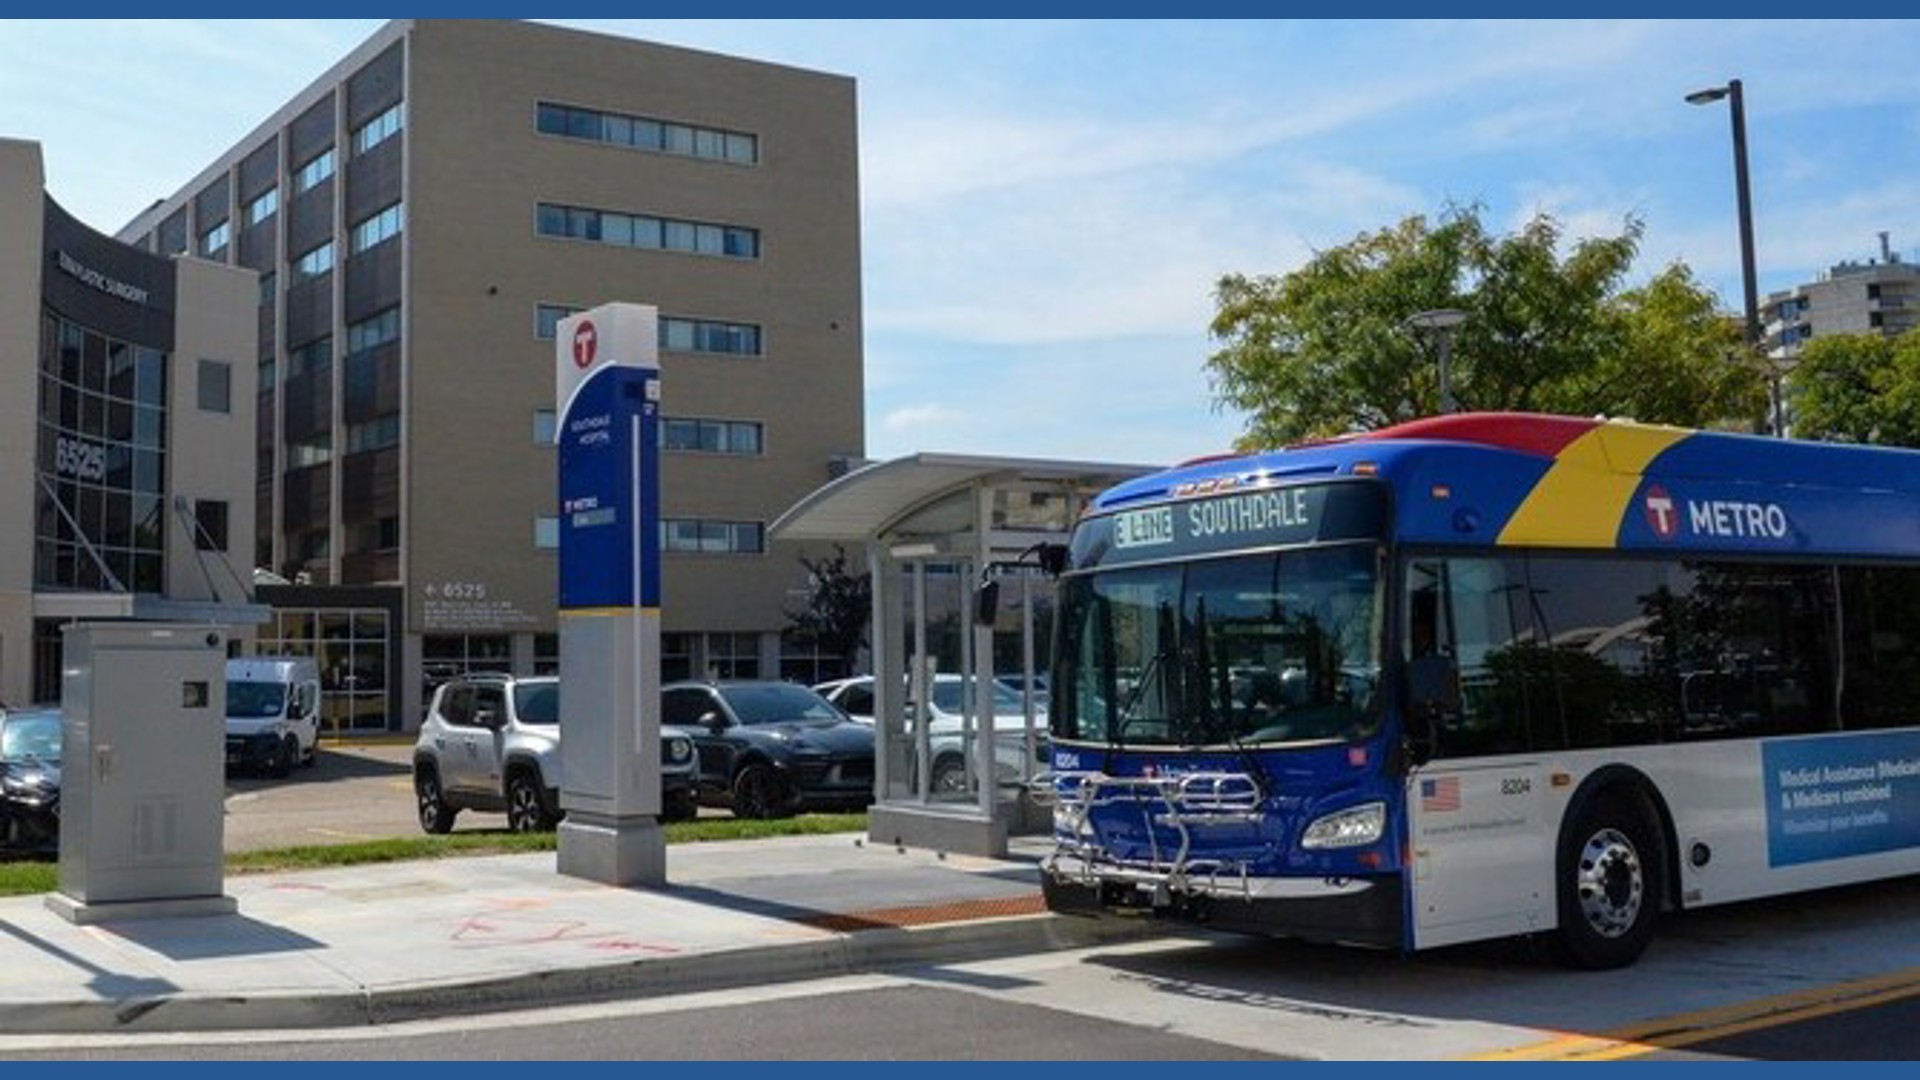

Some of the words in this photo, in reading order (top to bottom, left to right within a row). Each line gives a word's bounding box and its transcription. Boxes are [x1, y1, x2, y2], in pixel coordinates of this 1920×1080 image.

[57, 438, 104, 479] 6525
[1130, 510, 1170, 542] LINE
[1188, 488, 1308, 537] SOUTHDALE
[1688, 500, 1787, 538] METRO
[444, 583, 485, 599] 6525
[1501, 777, 1531, 795] 8204
[1780, 768, 1820, 787] Medical
[1822, 766, 1875, 784] Assistance
[1793, 790, 1840, 809] Medicare
[1841, 783, 1891, 804] combined
